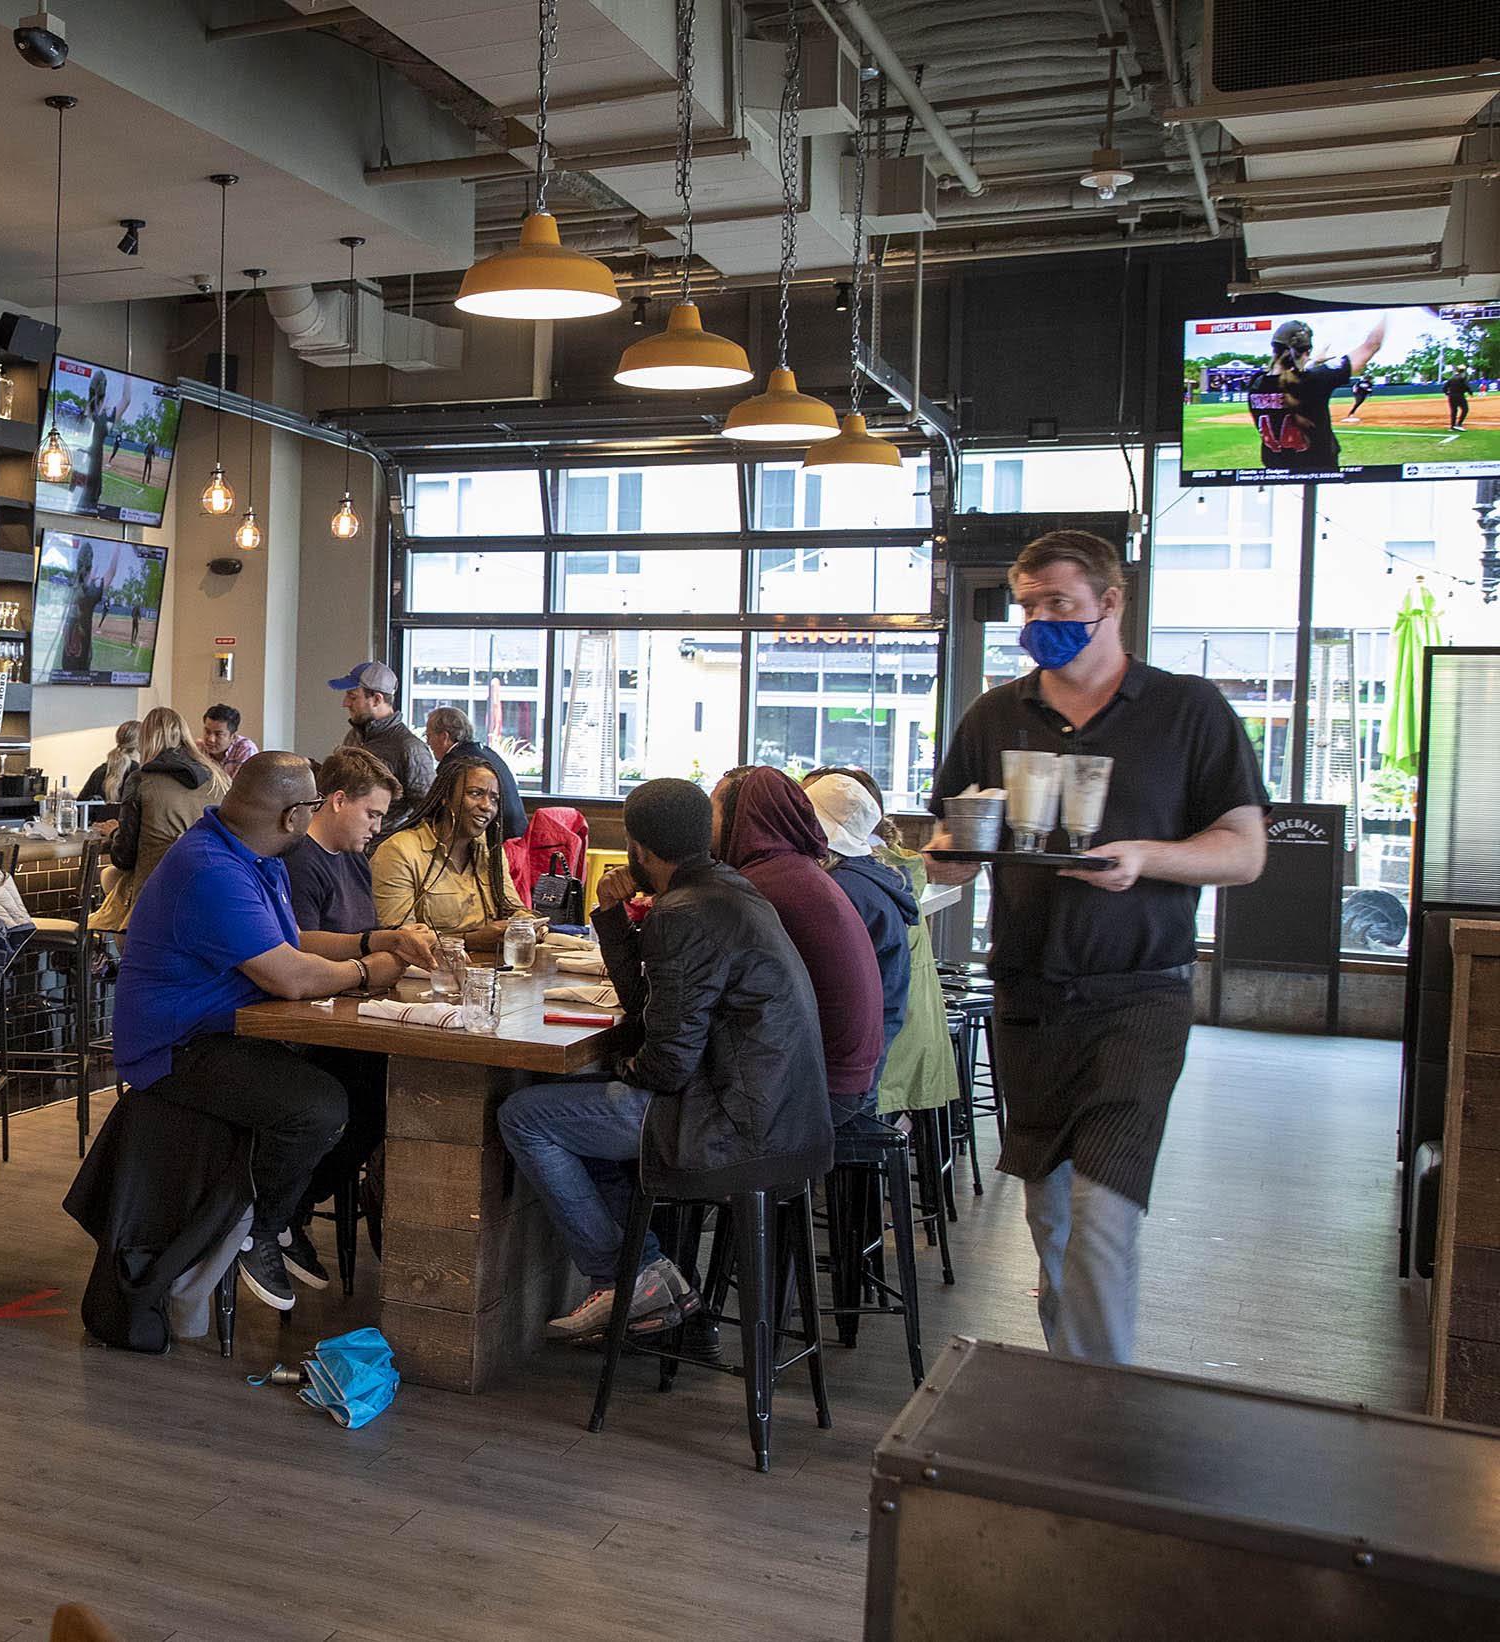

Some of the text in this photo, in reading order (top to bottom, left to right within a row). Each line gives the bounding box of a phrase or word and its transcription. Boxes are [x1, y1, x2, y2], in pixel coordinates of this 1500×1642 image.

[1211, 322, 1256, 334] HOME RUN
[1267, 818, 1323, 839] FIREBALL
